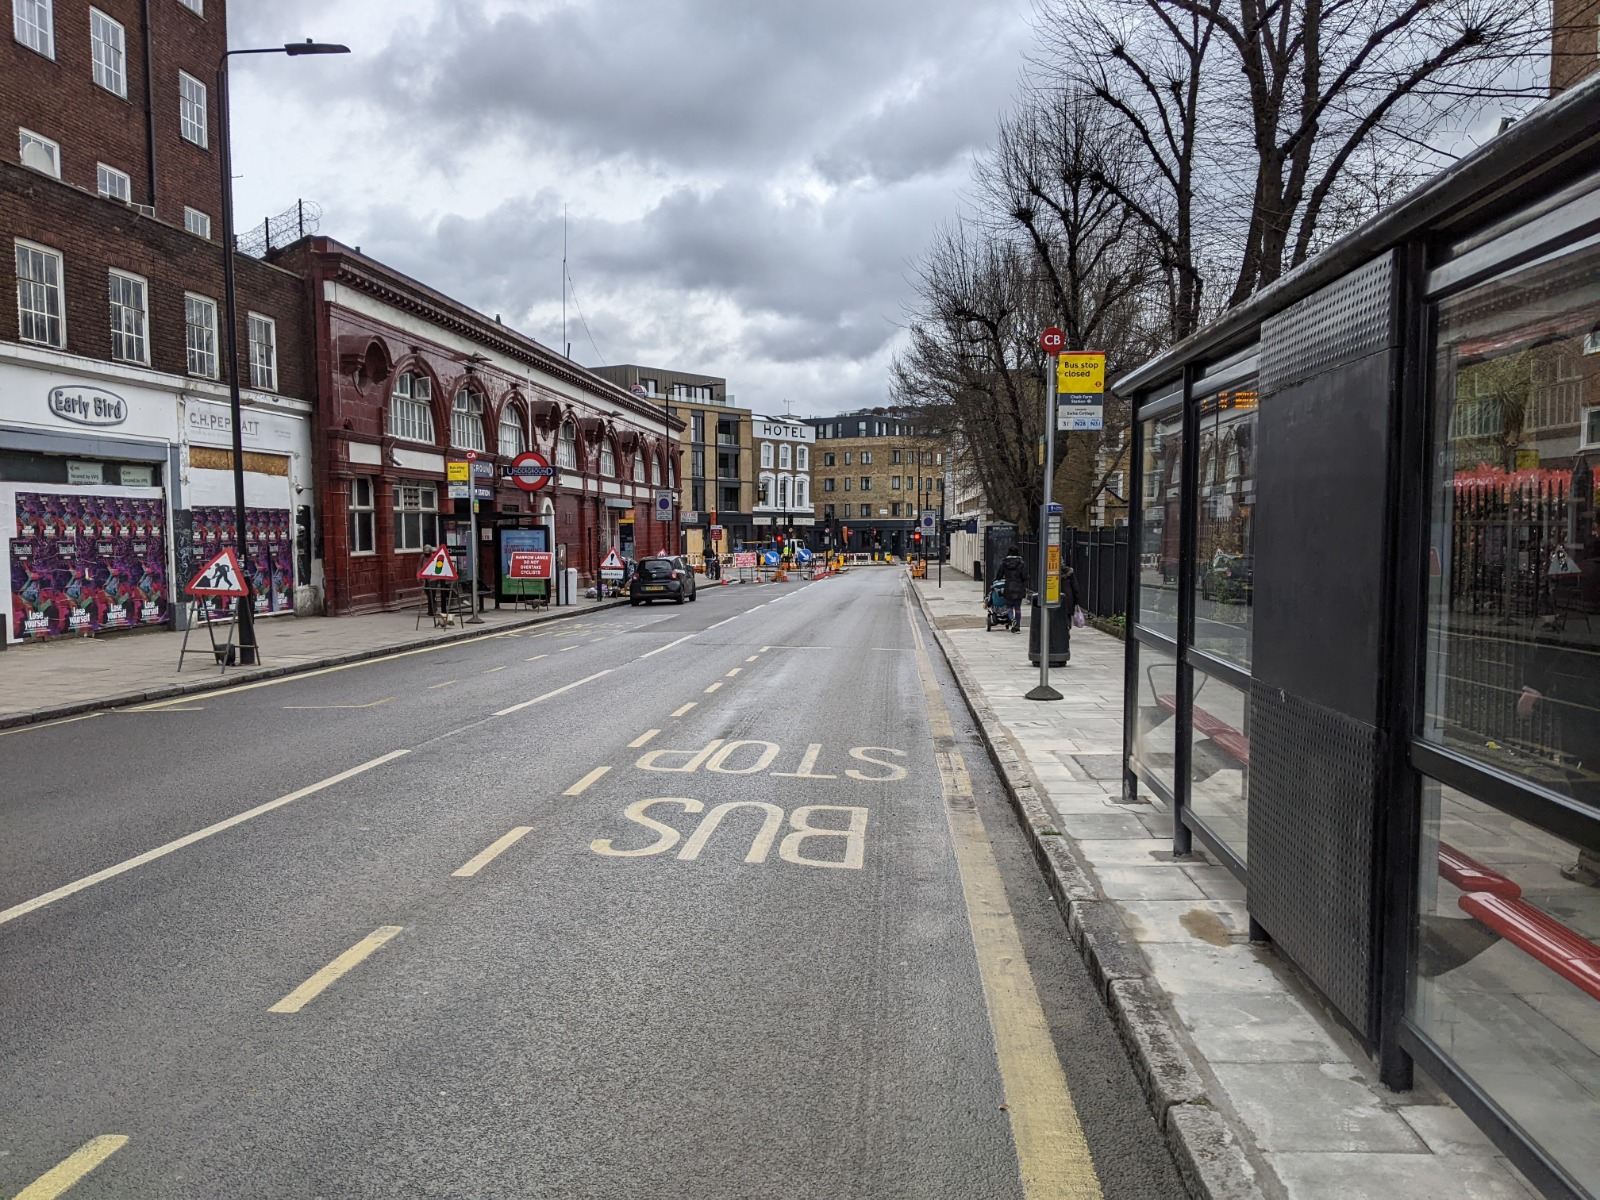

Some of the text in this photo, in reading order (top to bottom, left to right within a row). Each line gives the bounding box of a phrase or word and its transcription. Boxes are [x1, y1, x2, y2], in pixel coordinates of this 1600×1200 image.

[1044, 335, 1061, 345] CB
[55, 390, 122, 419] Early Bird
[764, 424, 806, 438] HOTEL
[506, 467, 553, 475] UNDERGROUND
[29, 611, 43, 620] Lose
[73, 607, 86, 616] Lose
[25, 617, 49, 630] yourself
[69, 613, 90, 624] yourself
[636, 739, 908, 781] STOP
[590, 798, 868, 870] BUS
